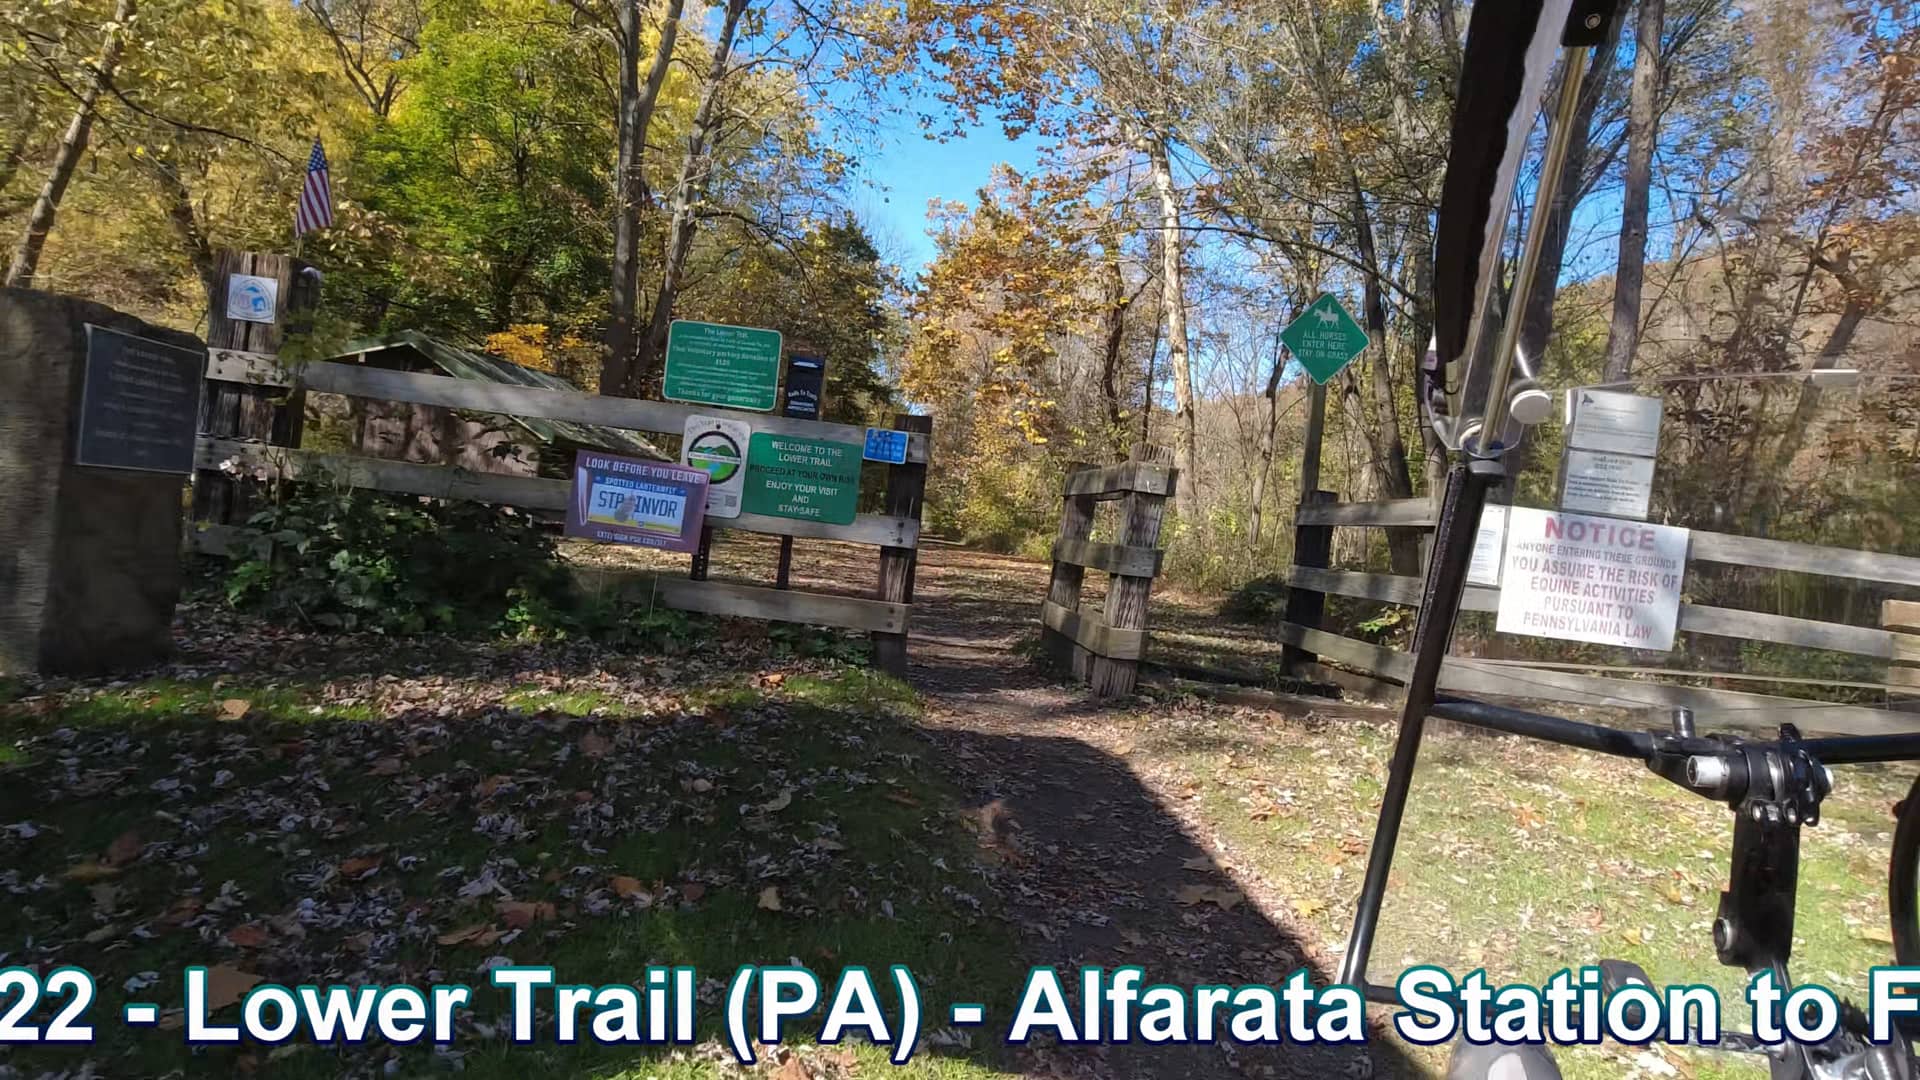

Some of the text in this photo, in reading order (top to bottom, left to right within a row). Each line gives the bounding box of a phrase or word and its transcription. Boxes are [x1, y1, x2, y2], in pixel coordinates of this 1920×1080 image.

[1303, 329, 1346, 340] ALL HORSES
[1302, 340, 1345, 350] ENTER HERE
[772, 440, 843, 457] WELCOME TO THE
[779, 453, 833, 467] LOWER TRAIL
[586, 457, 700, 484] LOOK BEFORE YOU LEAVE
[749, 464, 785, 475] PROCEED
[798, 470, 819, 479] YOUR
[821, 472, 838, 481] OWN
[606, 477, 677, 494] SPOTTED LANTERNFLY
[766, 480, 838, 496] ENJOY YOUR VISIT
[633, 495, 678, 519] INVDR
[792, 494, 809, 504] AND
[1545, 516, 1656, 550] NOTICE
[1517, 541, 1677, 569] ANYONE ENTERING THESE GROUNDS
[1512, 555, 1678, 588] YOU ASSUME THE RISK OF
[1531, 576, 1656, 605] EQUINE ACTIVITIES
[1544, 596, 1634, 621] PURSUANT TO
[1523, 611, 1653, 640] PENNSYLVANIA LAW
